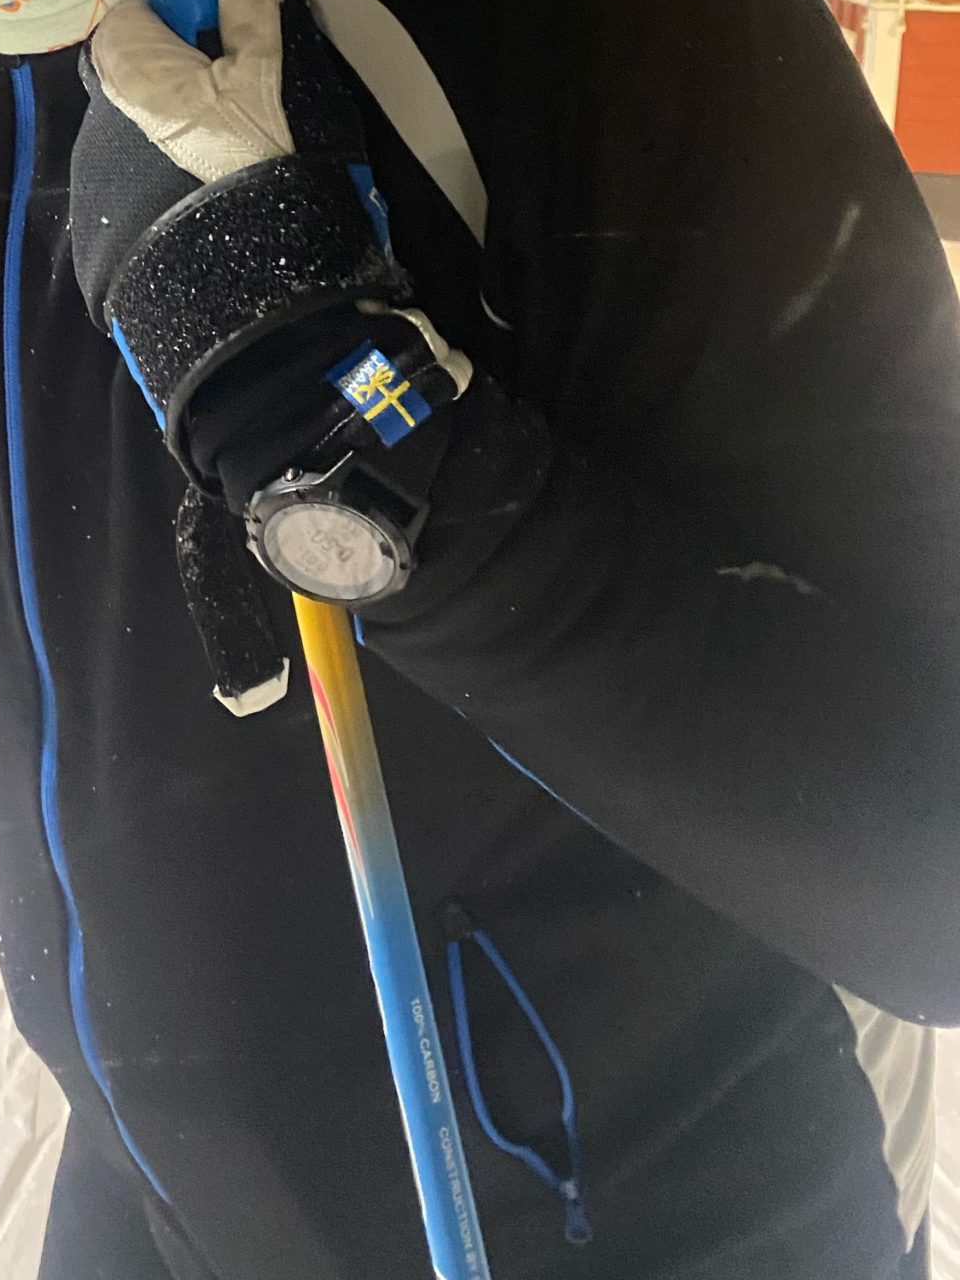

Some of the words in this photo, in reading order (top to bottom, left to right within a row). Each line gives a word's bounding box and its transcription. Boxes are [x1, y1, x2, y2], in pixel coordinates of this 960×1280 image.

[345, 354, 385, 395] TEAM
[352, 365, 395, 404] SKI
[419, 1038, 441, 1104] CARBON
[440, 1126, 474, 1251] CONSTRUCTION
